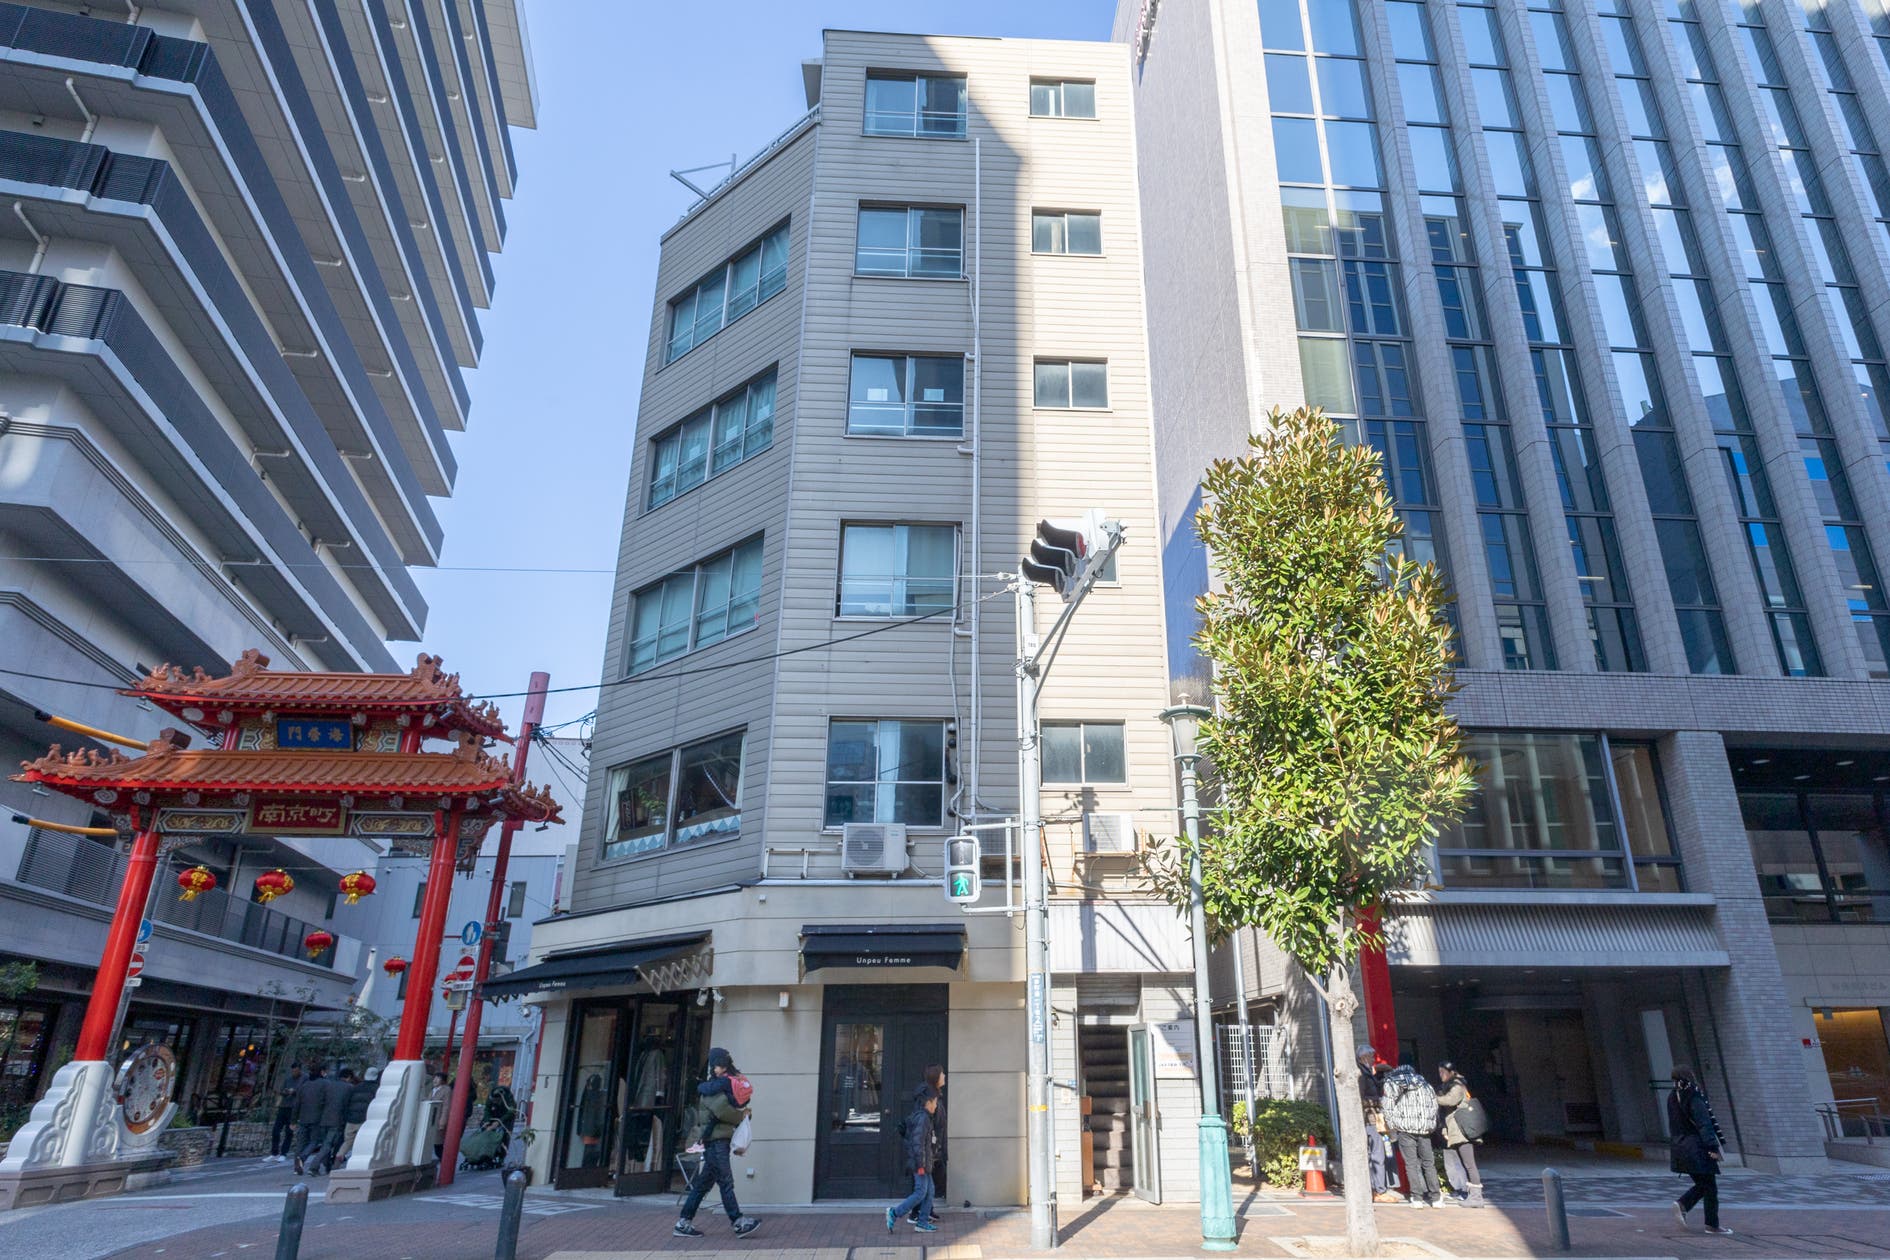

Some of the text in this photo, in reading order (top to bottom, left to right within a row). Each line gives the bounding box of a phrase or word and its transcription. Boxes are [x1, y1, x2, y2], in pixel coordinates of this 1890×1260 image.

[258, 803, 337, 823] 南京町
[856, 956, 911, 965] Unpeu Femme
